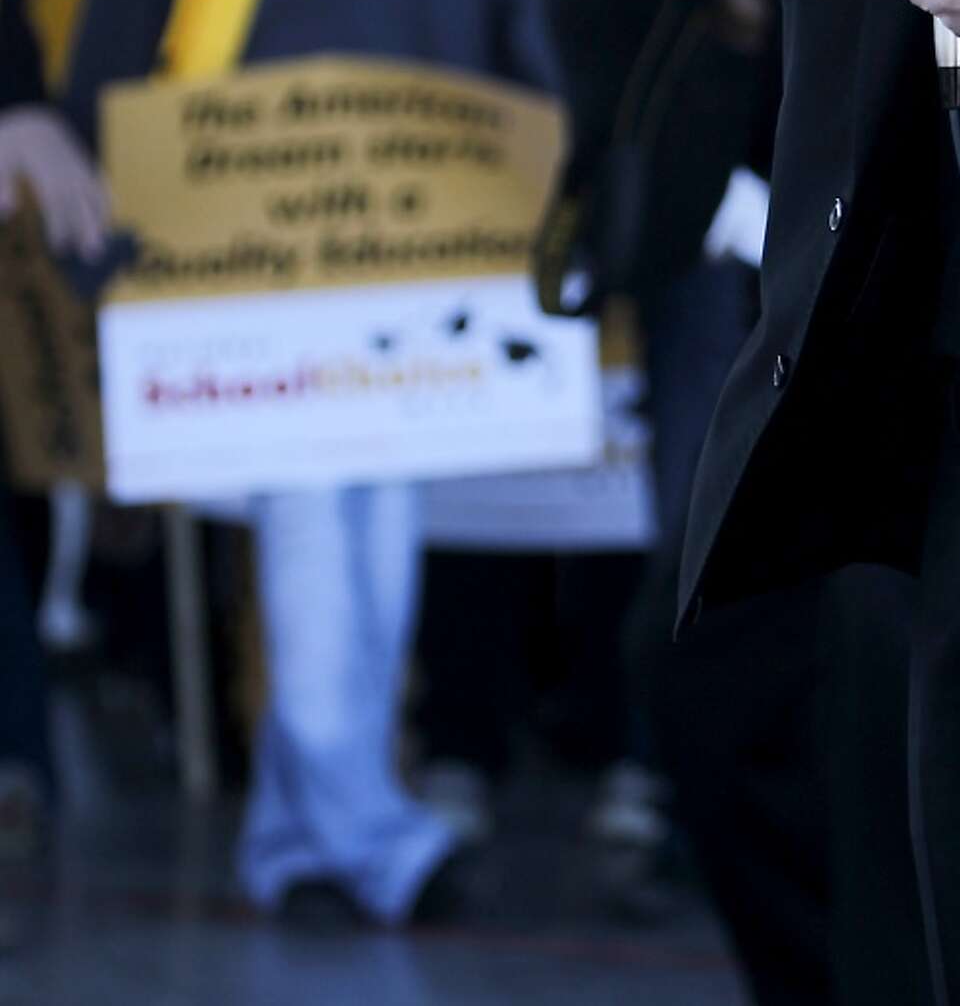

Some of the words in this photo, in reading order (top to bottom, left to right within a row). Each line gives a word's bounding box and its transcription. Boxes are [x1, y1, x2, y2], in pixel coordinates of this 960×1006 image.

[187, 135, 344, 177] Dream
[268, 182, 370, 222] with
[393, 187, 424, 215] a
